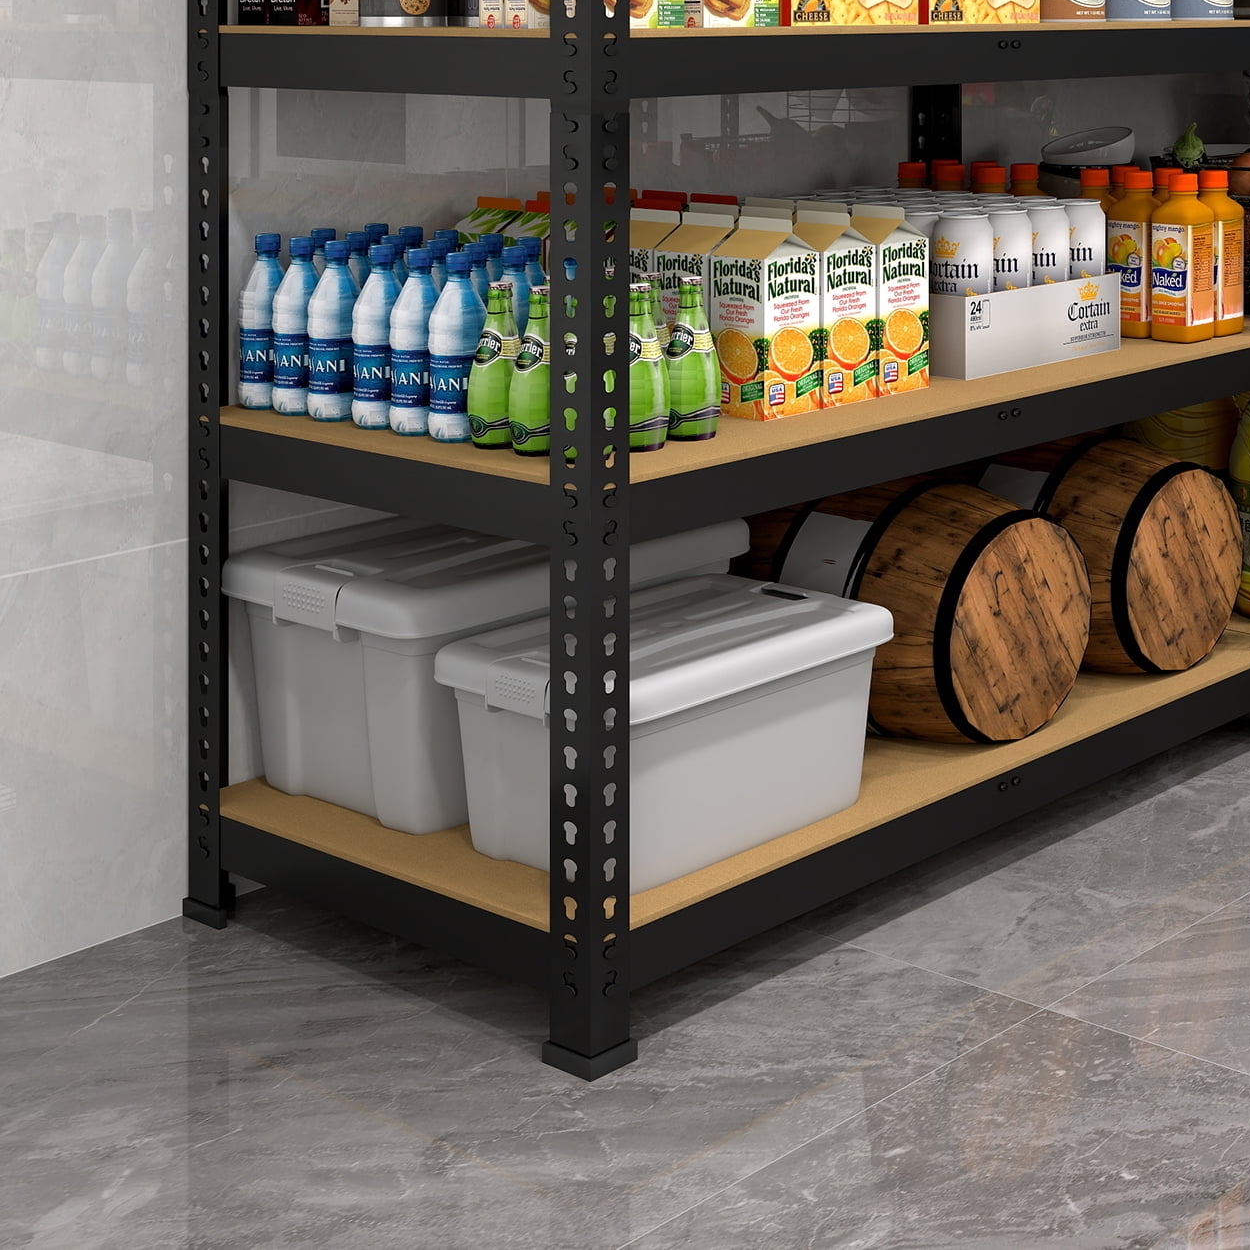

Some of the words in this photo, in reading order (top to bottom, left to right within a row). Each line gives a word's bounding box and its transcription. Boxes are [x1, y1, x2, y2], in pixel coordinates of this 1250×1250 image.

[795, 12, 829, 22] CHEESE
[932, 12, 963, 21] CHEESE
[656, 254, 702, 277] Florida's
[827, 249, 872, 273] Florida's
[882, 242, 925, 266] Florida's
[713, 259, 760, 284] Florida's
[767, 256, 816, 282] Florida's
[827, 269, 872, 292] Natural
[882, 261, 925, 284] Natural
[1152, 272, 1183, 288] Naked
[713, 278, 761, 303] Natural
[767, 277, 815, 301] Natural
[774, 300, 798, 309] Squeezed
[790, 312, 810, 320] Oranges
[970, 301, 981, 316] 24
[1067, 299, 1110, 322] Cortain
[1079, 319, 1099, 332] extra
[476, 336, 499, 351] errier
